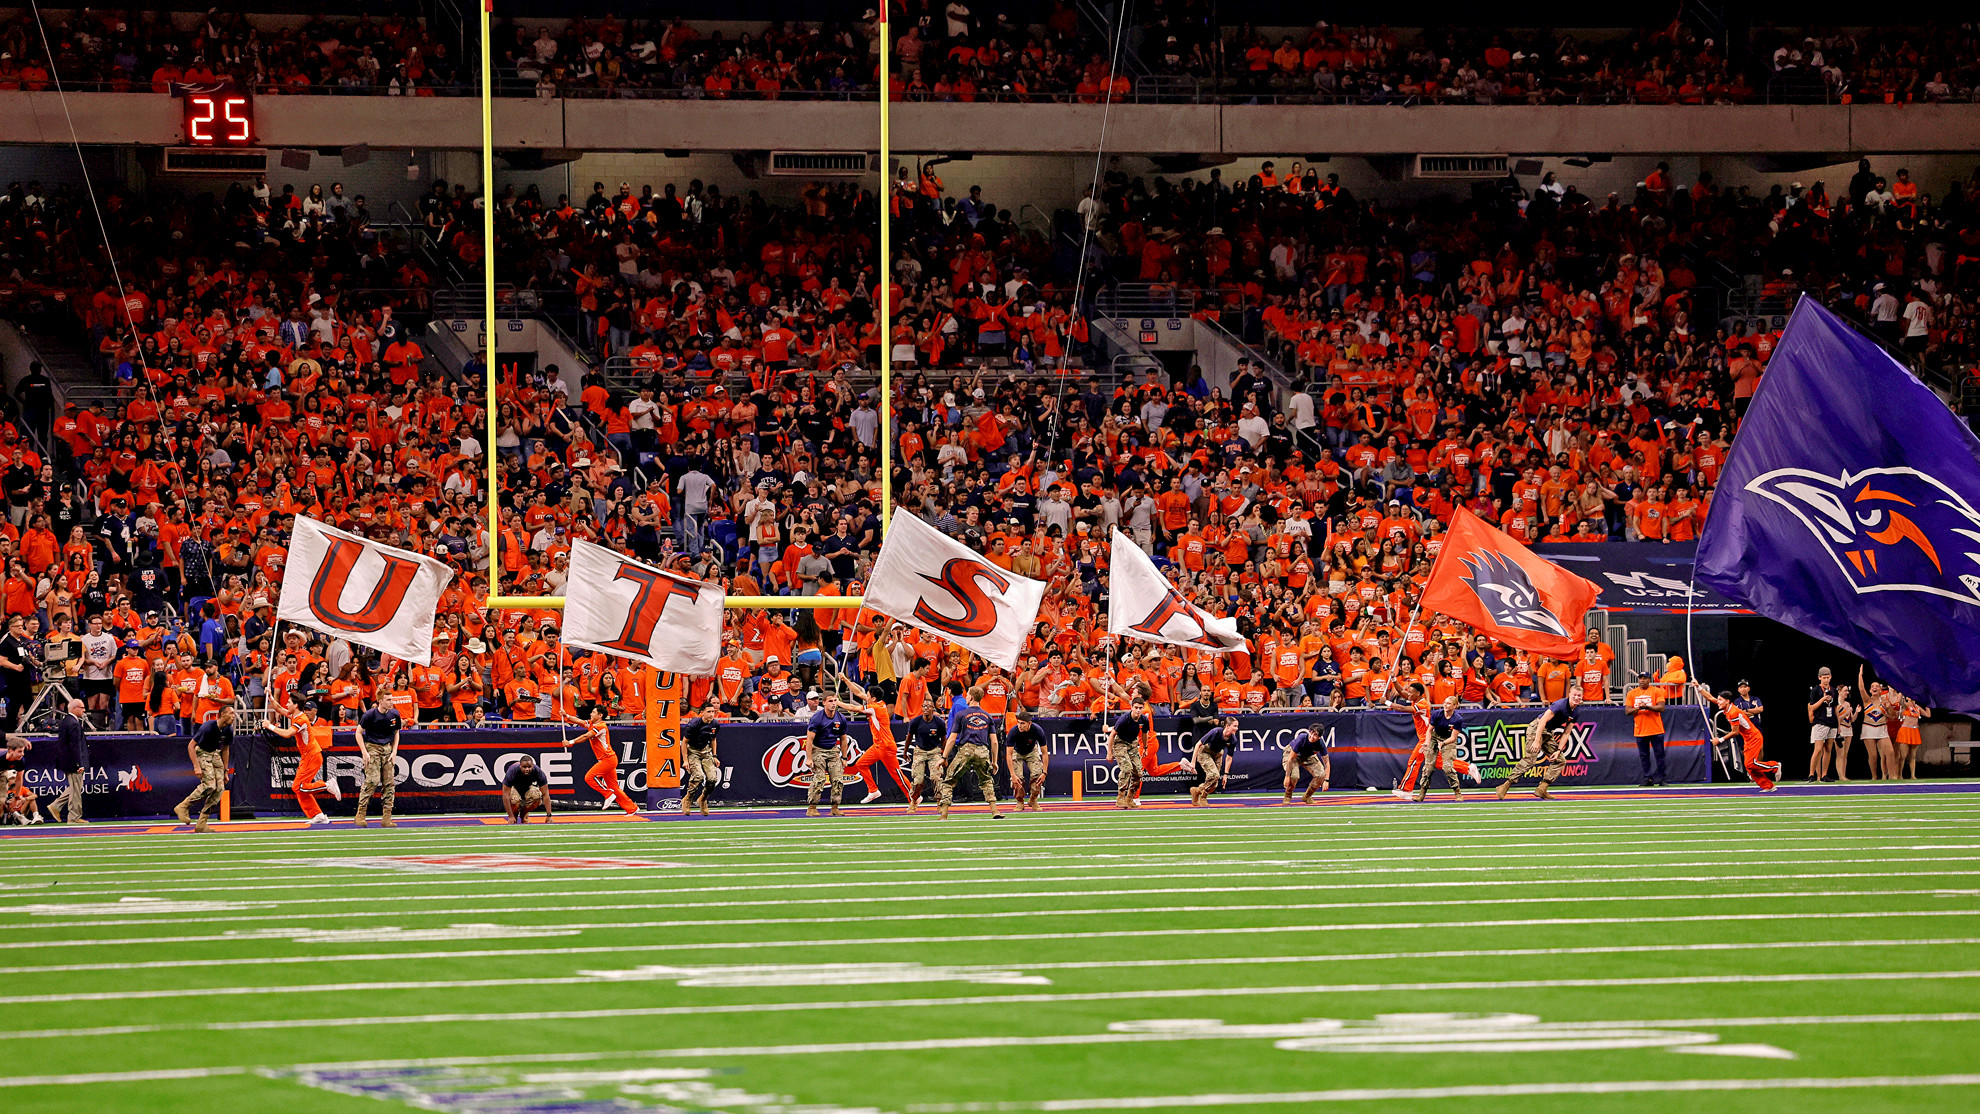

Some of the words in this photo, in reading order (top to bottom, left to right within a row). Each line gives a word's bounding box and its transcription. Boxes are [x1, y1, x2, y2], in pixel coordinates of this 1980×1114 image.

[191, 99, 249, 140] 25
[1447, 373, 1452, 384] 1
[785, 513, 795, 530] 0
[76, 578, 80, 590] 1
[309, 530, 421, 632] U
[912, 558, 1010, 637] S
[1623, 588, 1706, 598] USAA
[597, 561, 701, 657] T
[633, 682, 640, 697] 1
[655, 670, 677, 777] UTSA
[1455, 727, 1592, 762] BEATOX
[24, 766, 109, 783] GAUHA
[1525, 766, 1549, 778] PART
